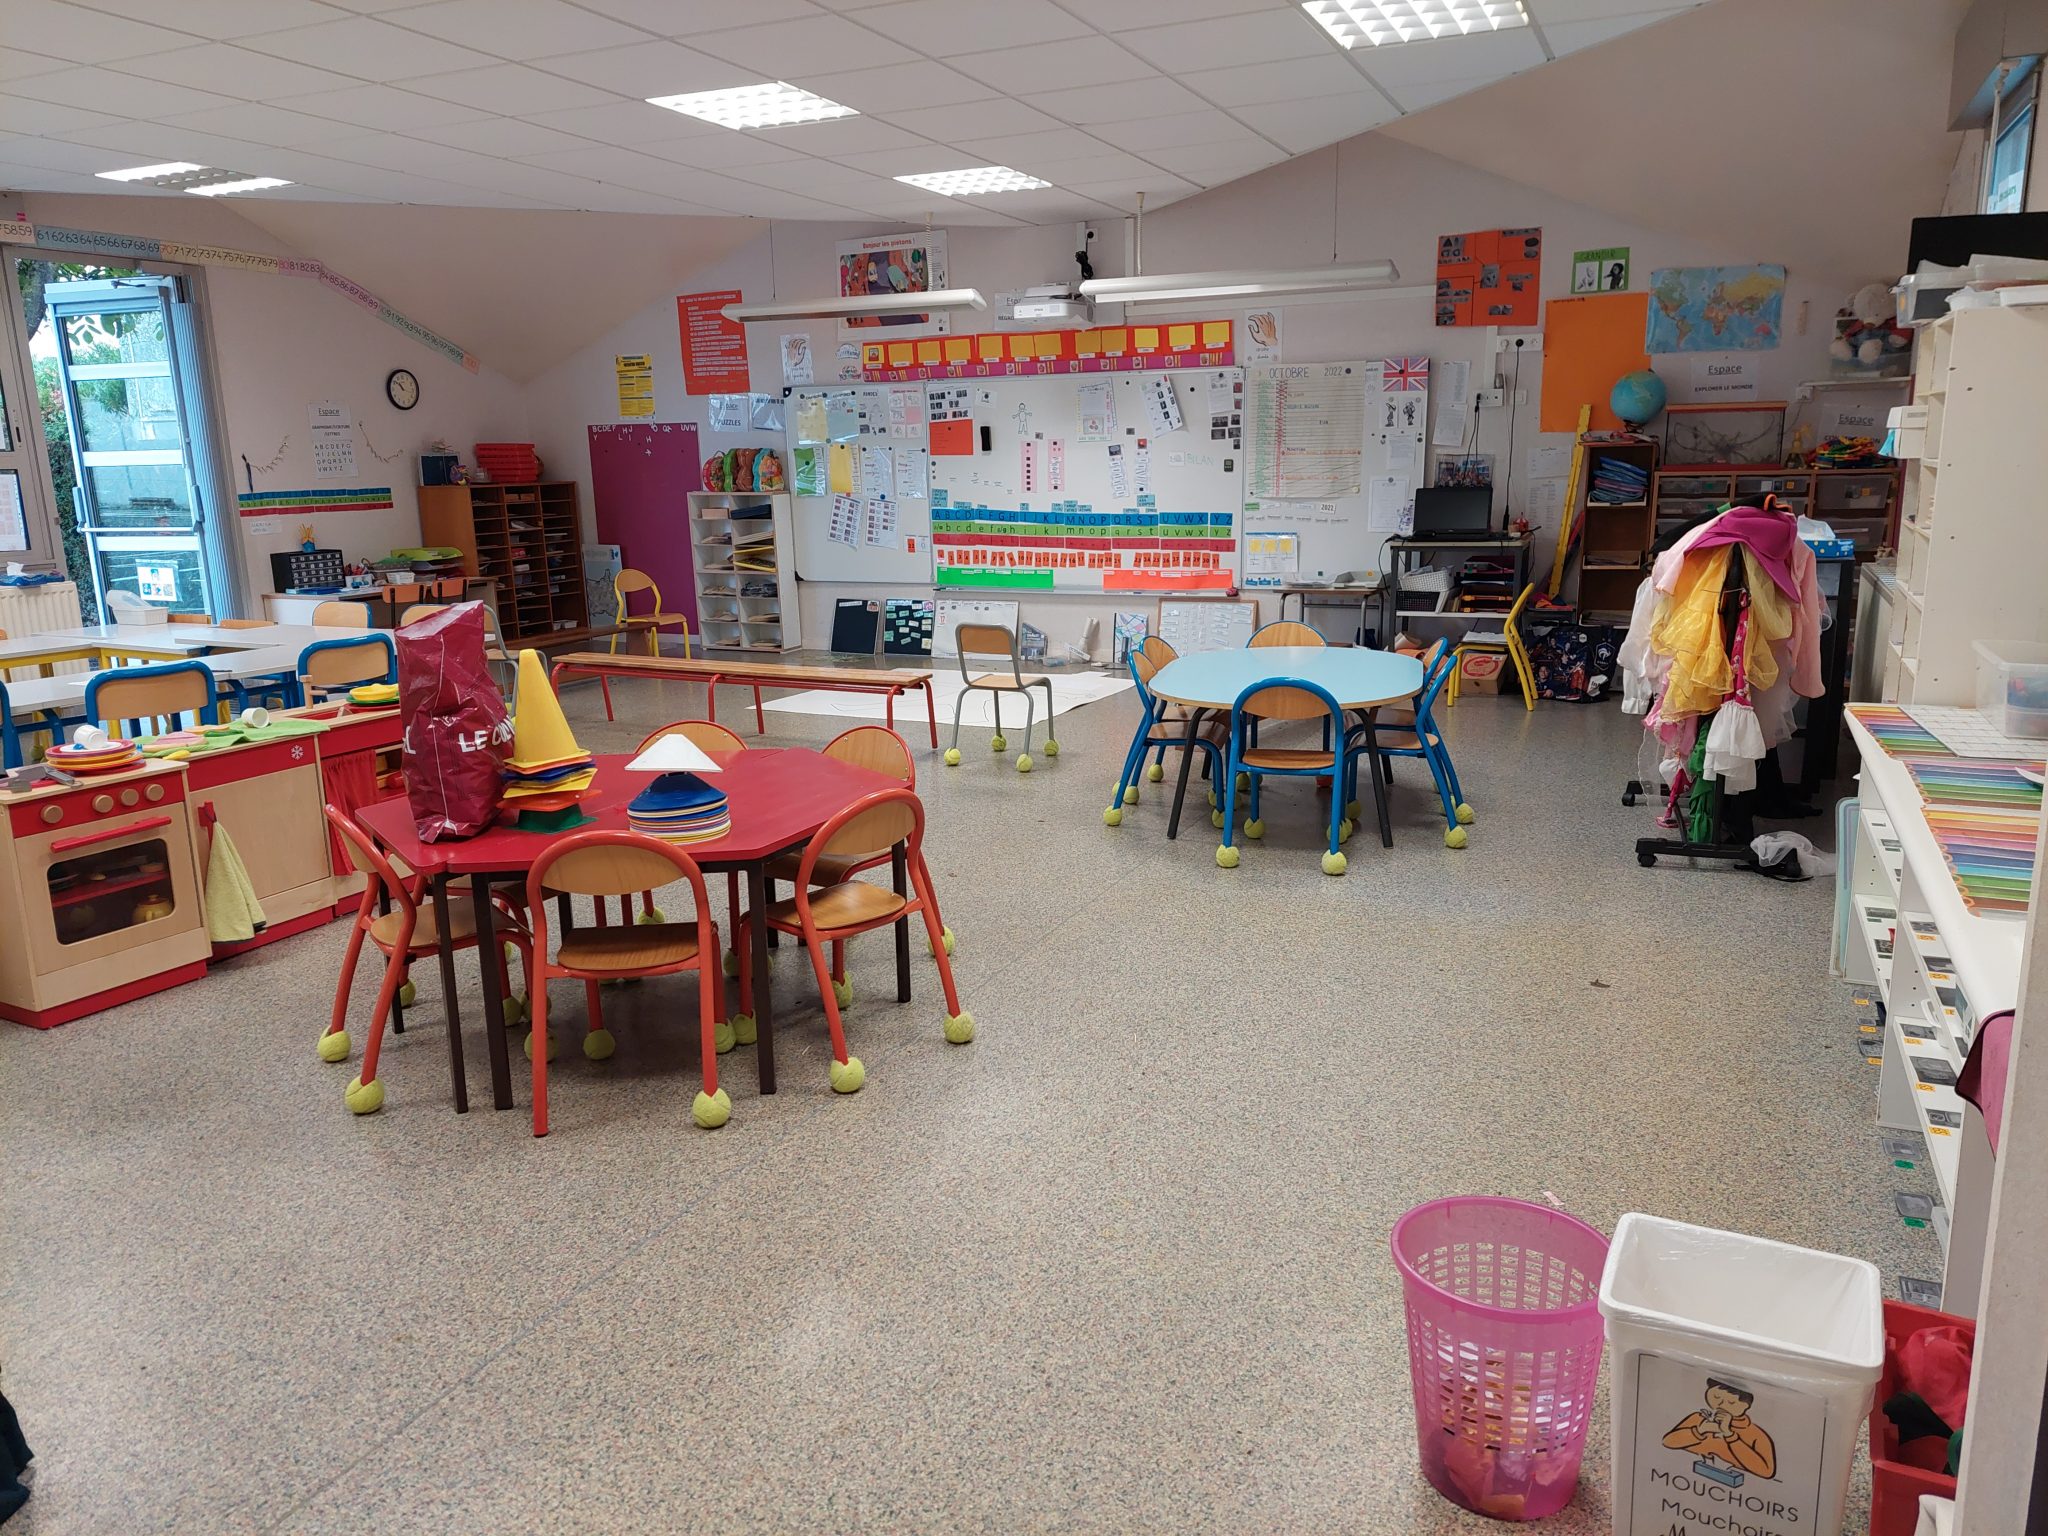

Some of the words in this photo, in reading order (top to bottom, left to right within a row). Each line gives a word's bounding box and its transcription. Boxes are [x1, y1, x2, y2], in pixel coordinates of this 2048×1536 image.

[1269, 367, 1310, 379] OCTOBRE
[1324, 367, 1342, 377] 2022
[1708, 365, 1742, 376] Espace
[318, 408, 340, 416] Espace
[1839, 414, 1874, 426] Espace
[1320, 504, 1334, 512] 2022
[458, 730, 488, 752] LE
[1651, 1468, 1798, 1522] MOUCHOIRS
[1662, 1498, 1783, 1536] Mouchoir
